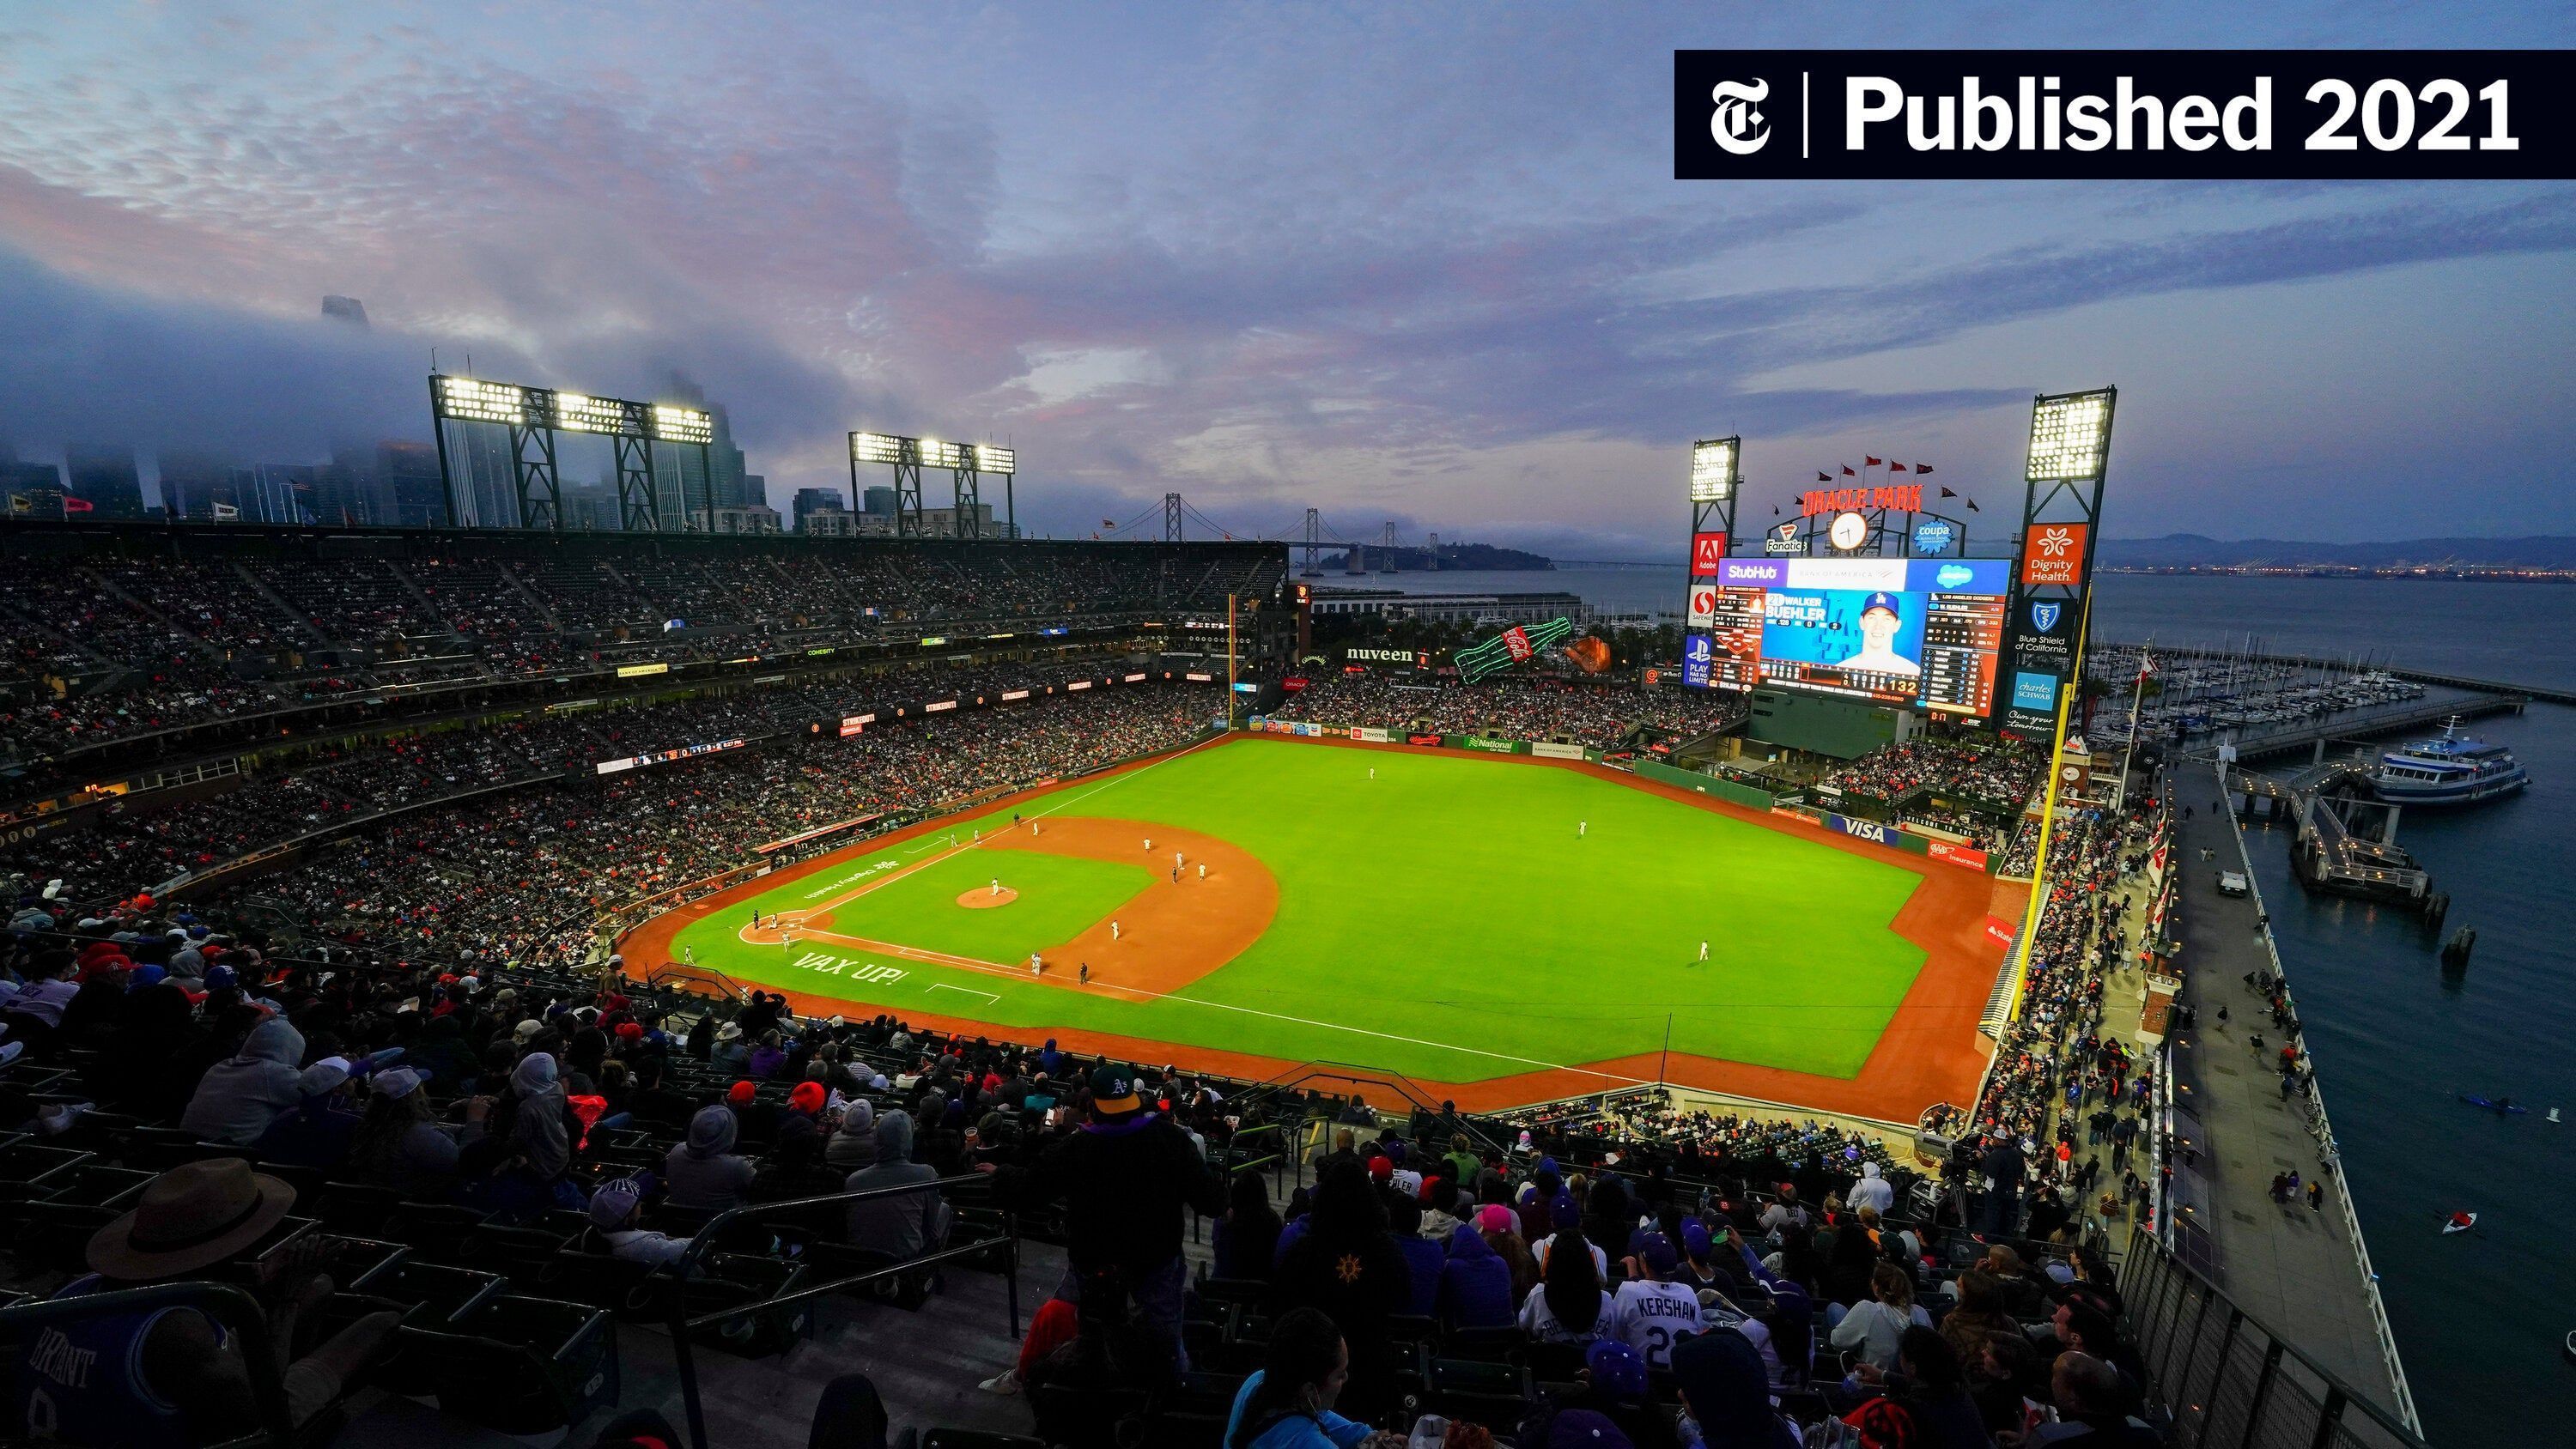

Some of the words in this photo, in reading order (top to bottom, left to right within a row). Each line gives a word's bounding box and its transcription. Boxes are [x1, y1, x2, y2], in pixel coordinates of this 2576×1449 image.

[1802, 488, 1868, 517] ORACLE
[1874, 485, 1923, 512] PARK
[1919, 527, 1949, 537] coupa
[1767, 541, 1807, 551] Fanatics
[1728, 566, 1777, 579] StubHub
[2031, 560, 2073, 572] Dignity
[1784, 597, 1822, 607] WALKER
[1765, 606, 1826, 621] BUEHLER
[2020, 635, 2036, 644] Blue
[2039, 636, 2064, 645] Shield
[1507, 636, 1530, 658] Cola
[2026, 645, 2067, 653] California
[1346, 647, 1413, 662] nuveen
[1690, 664, 1708, 673] PLAY
[2020, 682, 2051, 693] charles
[1002, 690, 1029, 700] STRIKEOUT!
[2018, 691, 2050, 700] SCHWAB
[926, 700, 957, 712] STRIKEOUT!
[842, 713, 875, 727] STRIKEOUT!
[2008, 710, 2028, 720] Own
[2030, 715, 2053, 725] your
[2007, 720, 2054, 731] tomorrow
[1479, 738, 1512, 749] National
[2000, 729, 2025, 743] Coors
[2025, 736, 2047, 745] LIGHT
[1843, 817, 1885, 843] VISA
[1906, 816, 1938, 830] WELCOME
[1959, 828, 1972, 837] THE
[841, 869, 877, 885] Dignity
[804, 882, 842, 899] Health
[1996, 930, 2013, 943] State
[793, 952, 859, 975] VAX
[851, 963, 910, 985] UP!
[1786, 1210, 1799, 1218] BELT
[1637, 1297, 1696, 1322] KERSHAW
[28, 1326, 97, 1389] BRYANT
